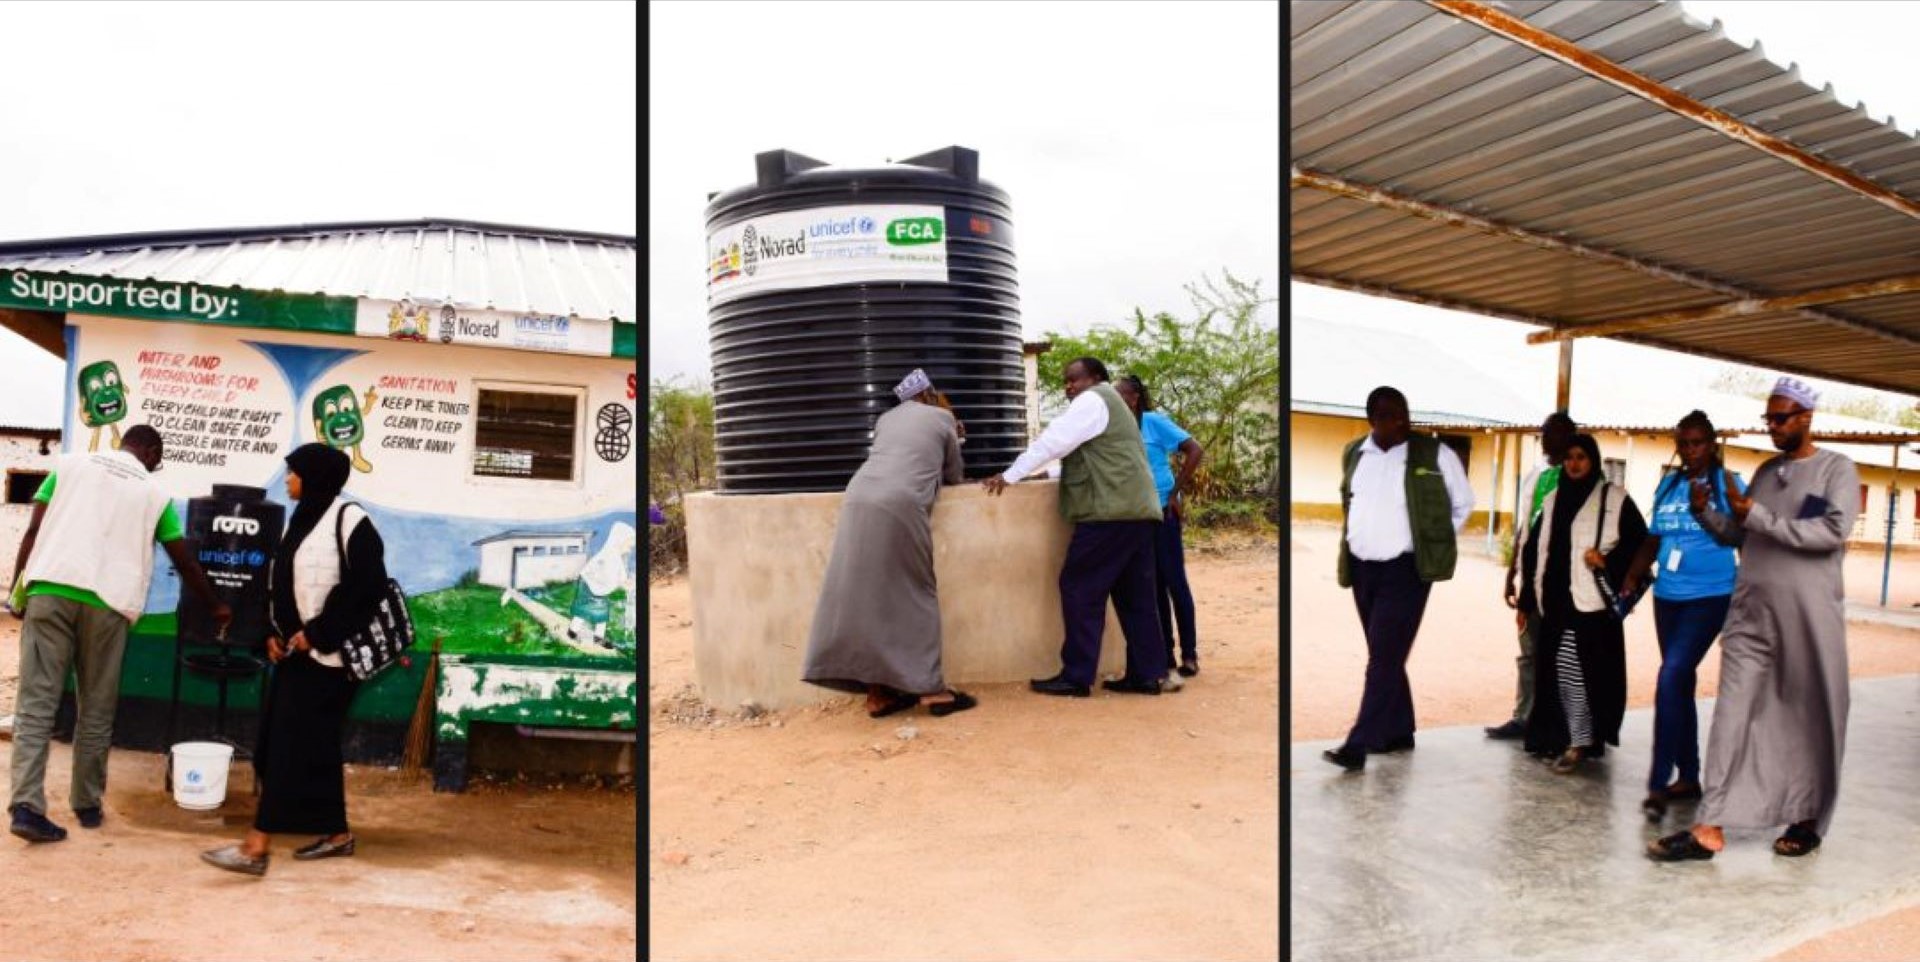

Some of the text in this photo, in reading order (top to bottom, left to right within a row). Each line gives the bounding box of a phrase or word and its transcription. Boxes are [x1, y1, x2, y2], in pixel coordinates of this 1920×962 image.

[809, 217, 856, 238] unicef
[894, 221, 936, 240] FCA
[760, 229, 805, 260] Norad
[10, 271, 239, 319] Supported by:
[458, 317, 500, 338] Norad
[514, 315, 552, 332] unicef
[138, 351, 221, 370] WATER AND
[226, 374, 259, 391] FOR
[379, 376, 458, 394] SANITATION
[141, 398, 183, 413] EVERY
[182, 403, 218, 417] CHILD
[240, 408, 282, 424] RIGHT
[381, 396, 413, 410] KEEP
[415, 398, 435, 413] THE
[147, 413, 272, 439] TO CLEAN SAFE AND
[383, 415, 463, 434] CLEAN TO KEEP
[162, 431, 278, 455] ESSIBLE WATER AND
[381, 435, 455, 454] GERMS AWAY
[162, 448, 227, 467] SHROOMS
[199, 549, 247, 565] unicef
